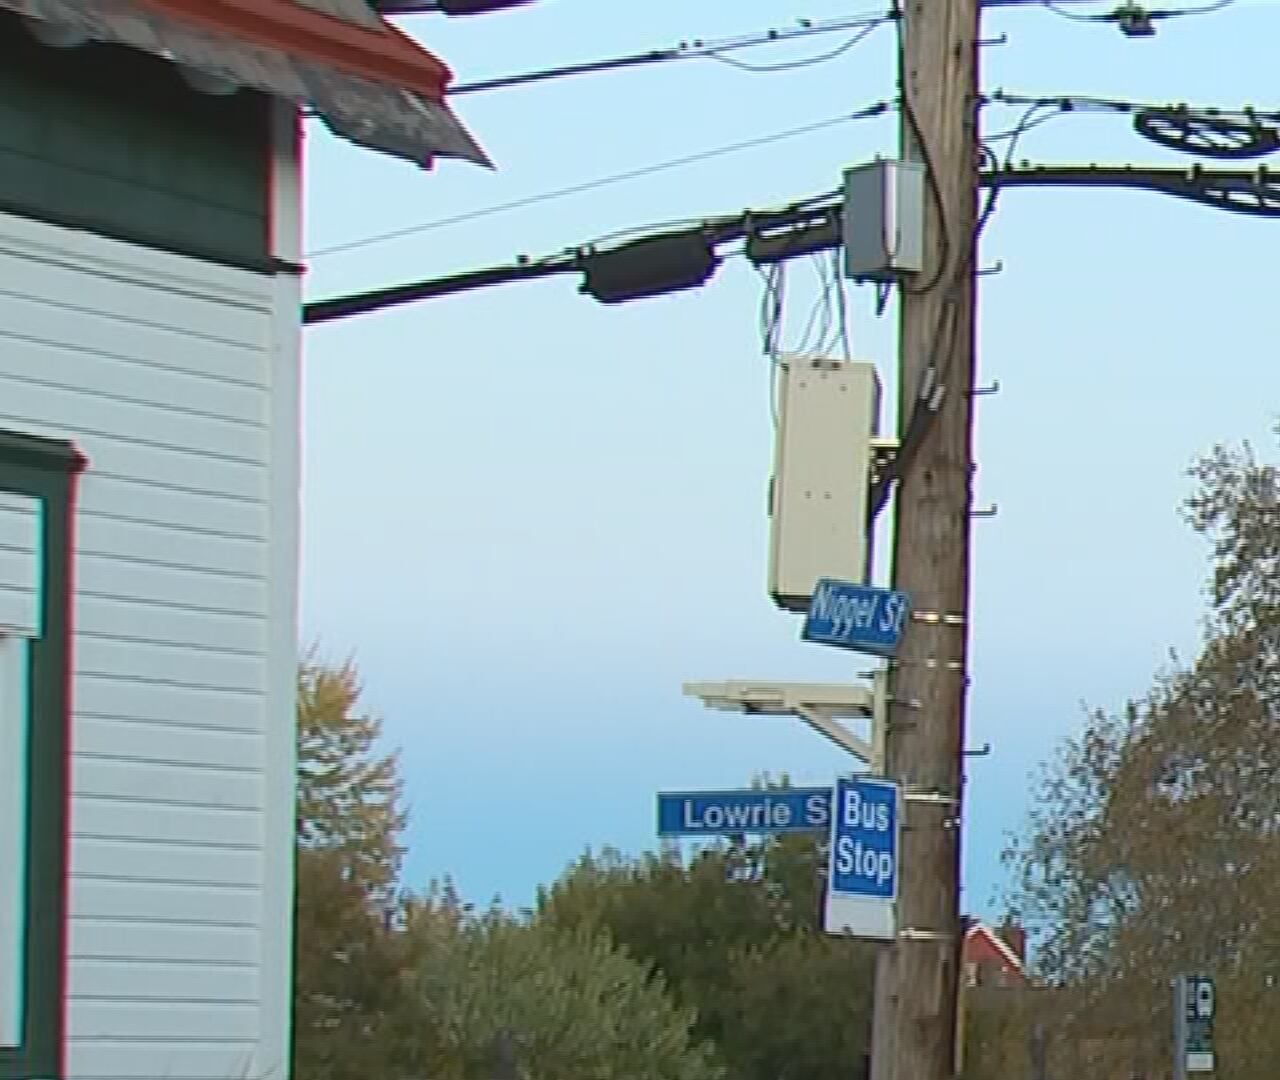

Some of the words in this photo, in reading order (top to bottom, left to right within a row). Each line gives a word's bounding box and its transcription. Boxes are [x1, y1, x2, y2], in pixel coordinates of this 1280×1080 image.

[684, 796, 790, 829] Lowrie
[806, 795, 830, 826] S
[844, 790, 889, 832] Bus
[837, 836, 892, 886] Stop
